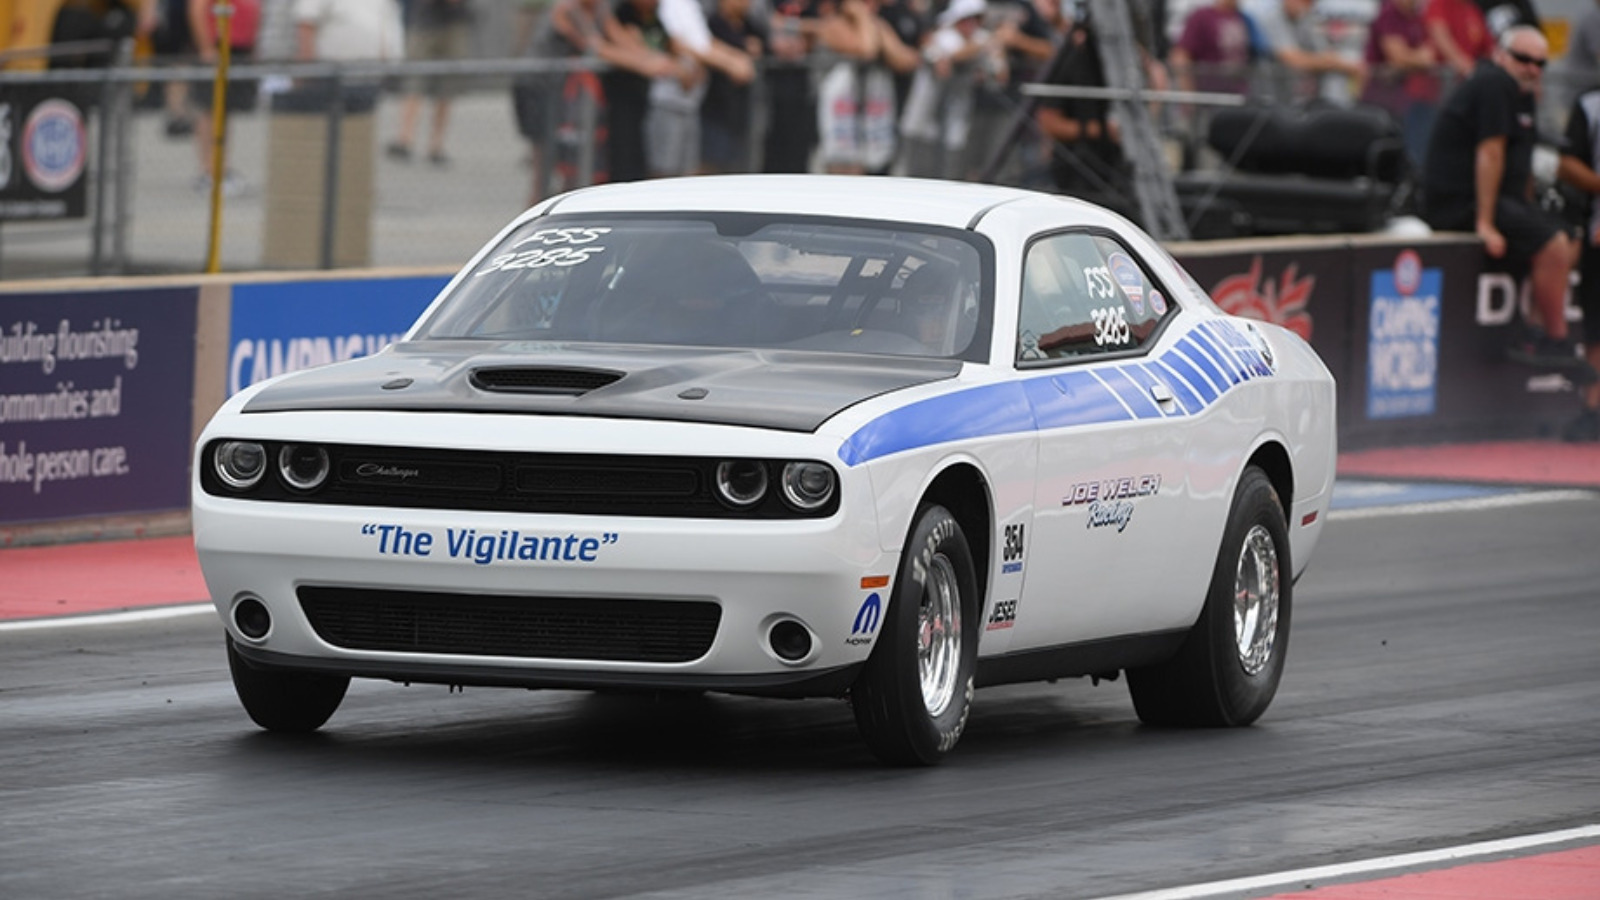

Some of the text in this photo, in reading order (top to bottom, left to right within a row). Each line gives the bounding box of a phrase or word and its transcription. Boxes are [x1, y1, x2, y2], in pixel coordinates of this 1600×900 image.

[511, 227, 612, 249] FSS
[475, 247, 605, 277] 3285
[1083, 265, 1115, 299] FSS
[1090, 306, 1130, 346] 3285
[0, 317, 139, 374] uilding flourishing
[0, 375, 122, 423] ommunities and
[0, 440, 130, 494] hole person care.
[356, 463, 419, 480] Challenger
[1062, 474, 1162, 506] JOE WELCH
[1086, 500, 1134, 533] Racing
[361, 524, 618, 565] “The Vigilante”
[1003, 523, 1024, 561] 354
